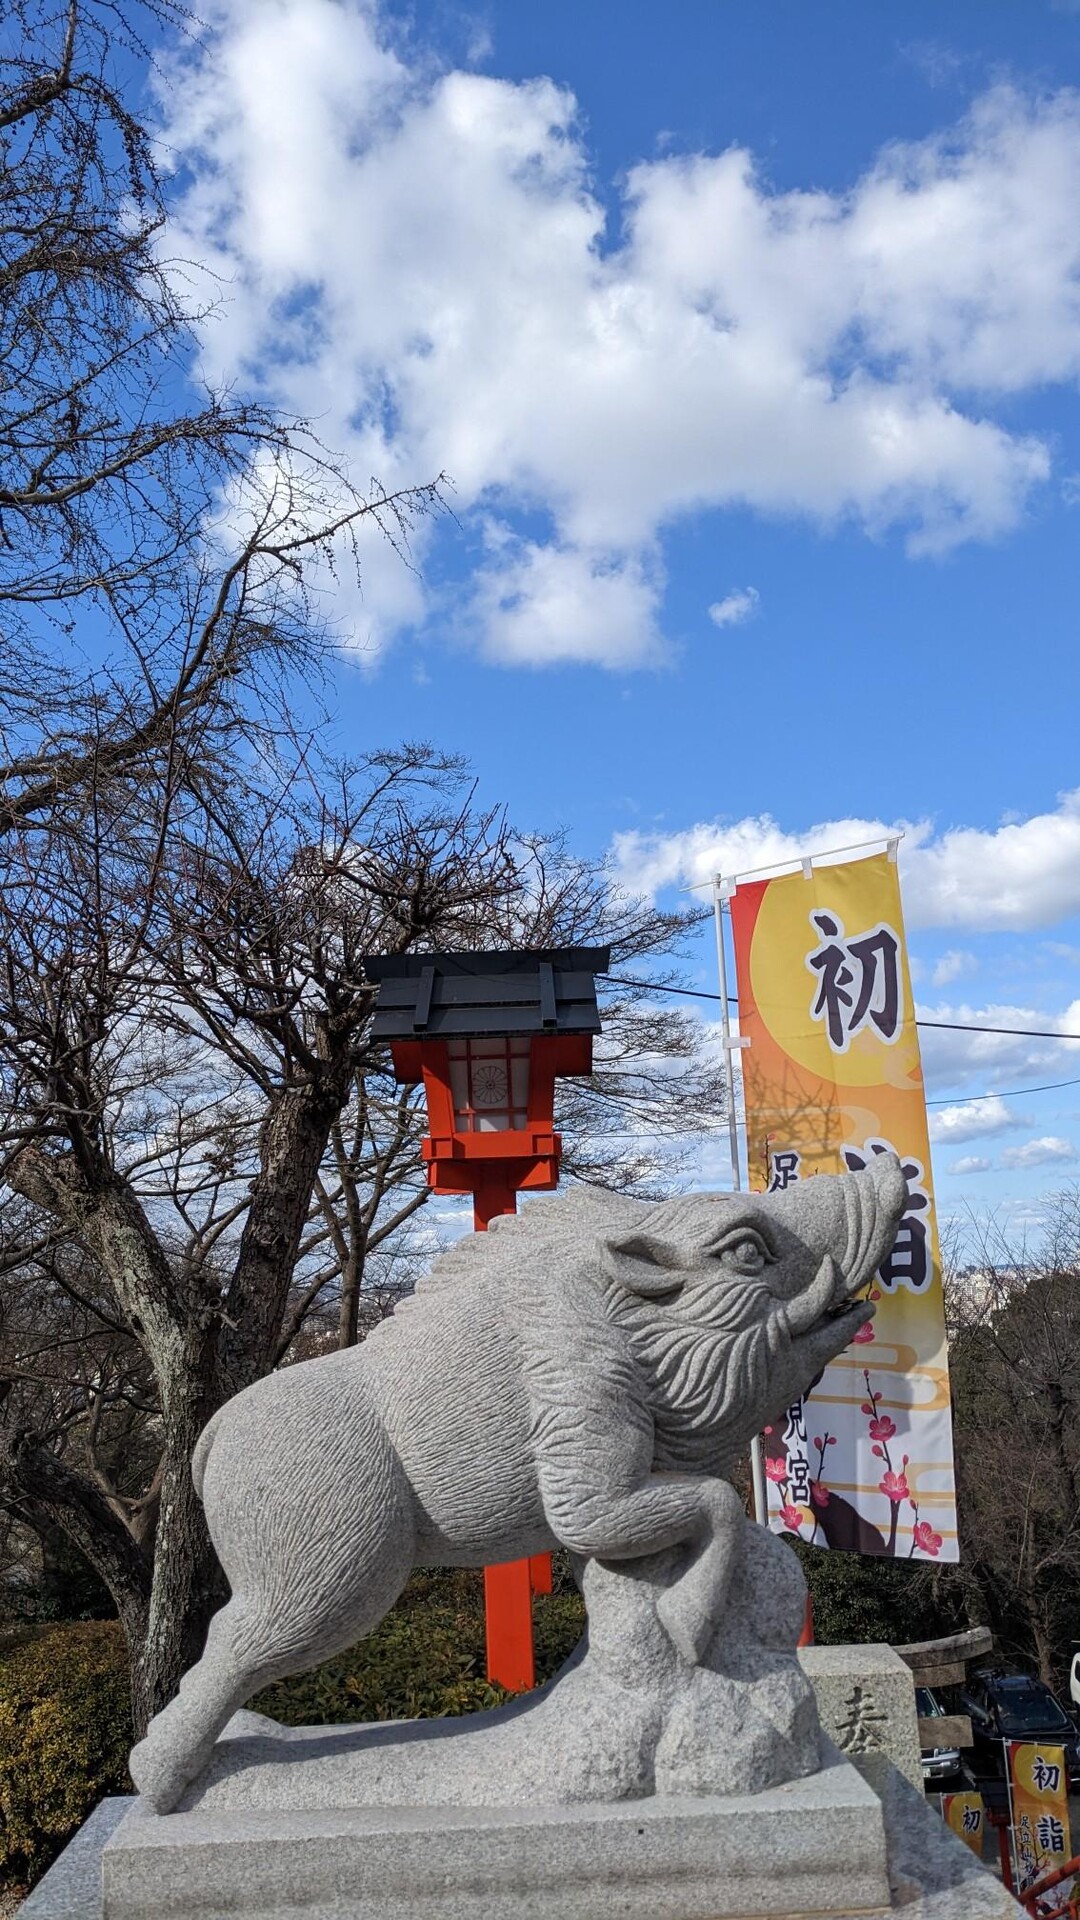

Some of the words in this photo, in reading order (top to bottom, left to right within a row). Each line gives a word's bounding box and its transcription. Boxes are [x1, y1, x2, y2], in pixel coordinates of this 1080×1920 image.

[769, 1153, 799, 1193] 足
[963, 1805, 981, 1832] 初
[1033, 1756, 1064, 1853] 初詣
